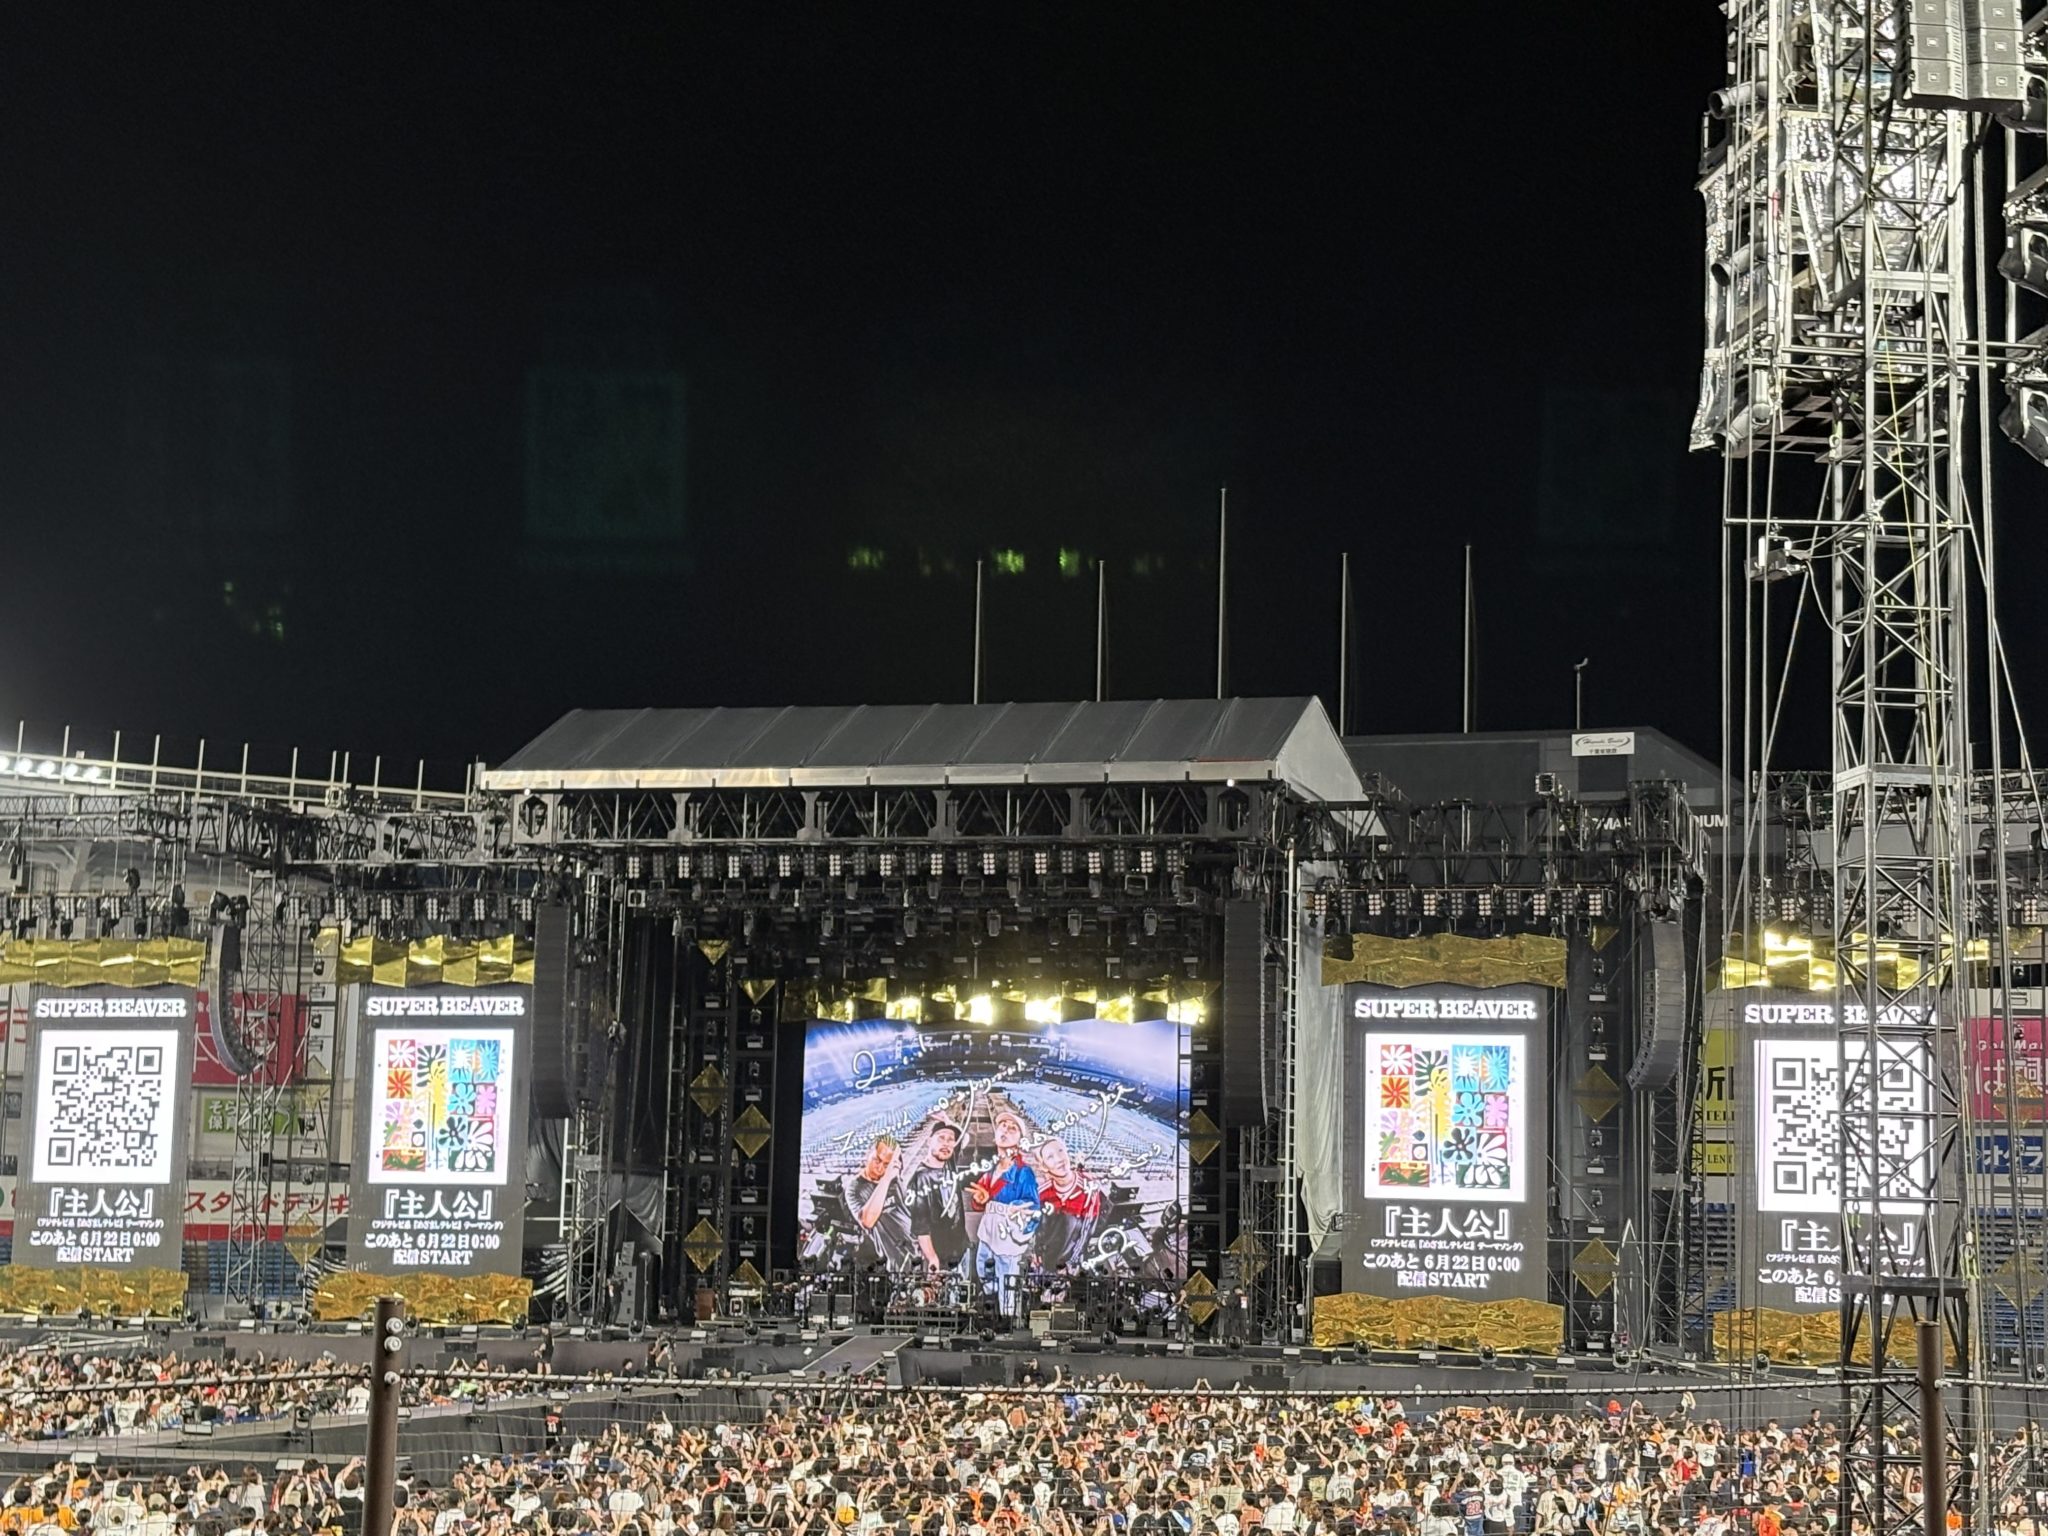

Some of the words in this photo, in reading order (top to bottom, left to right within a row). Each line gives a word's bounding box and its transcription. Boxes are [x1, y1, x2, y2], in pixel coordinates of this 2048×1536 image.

[36, 998, 104, 1018] SUPER
[105, 998, 187, 1018] BEAVER
[366, 997, 439, 1016] SUPER
[440, 997, 524, 1016] BEAVER
[1355, 999, 1437, 1018] SUPER
[1438, 1000, 1537, 1019] BEAVER
[1745, 1004, 1835, 1024] SUPER
[49, 1187, 153, 1217] 『主人公』
[385, 1189, 493, 1220] 『主人公』
[1385, 1206, 1510, 1240] 『主人公』
[56, 1247, 134, 1263] 配信START
[393, 1249, 473, 1265] 配信START
[1397, 1270, 1491, 1288] 配信START
[1758, 1267, 1819, 1285] このあと
